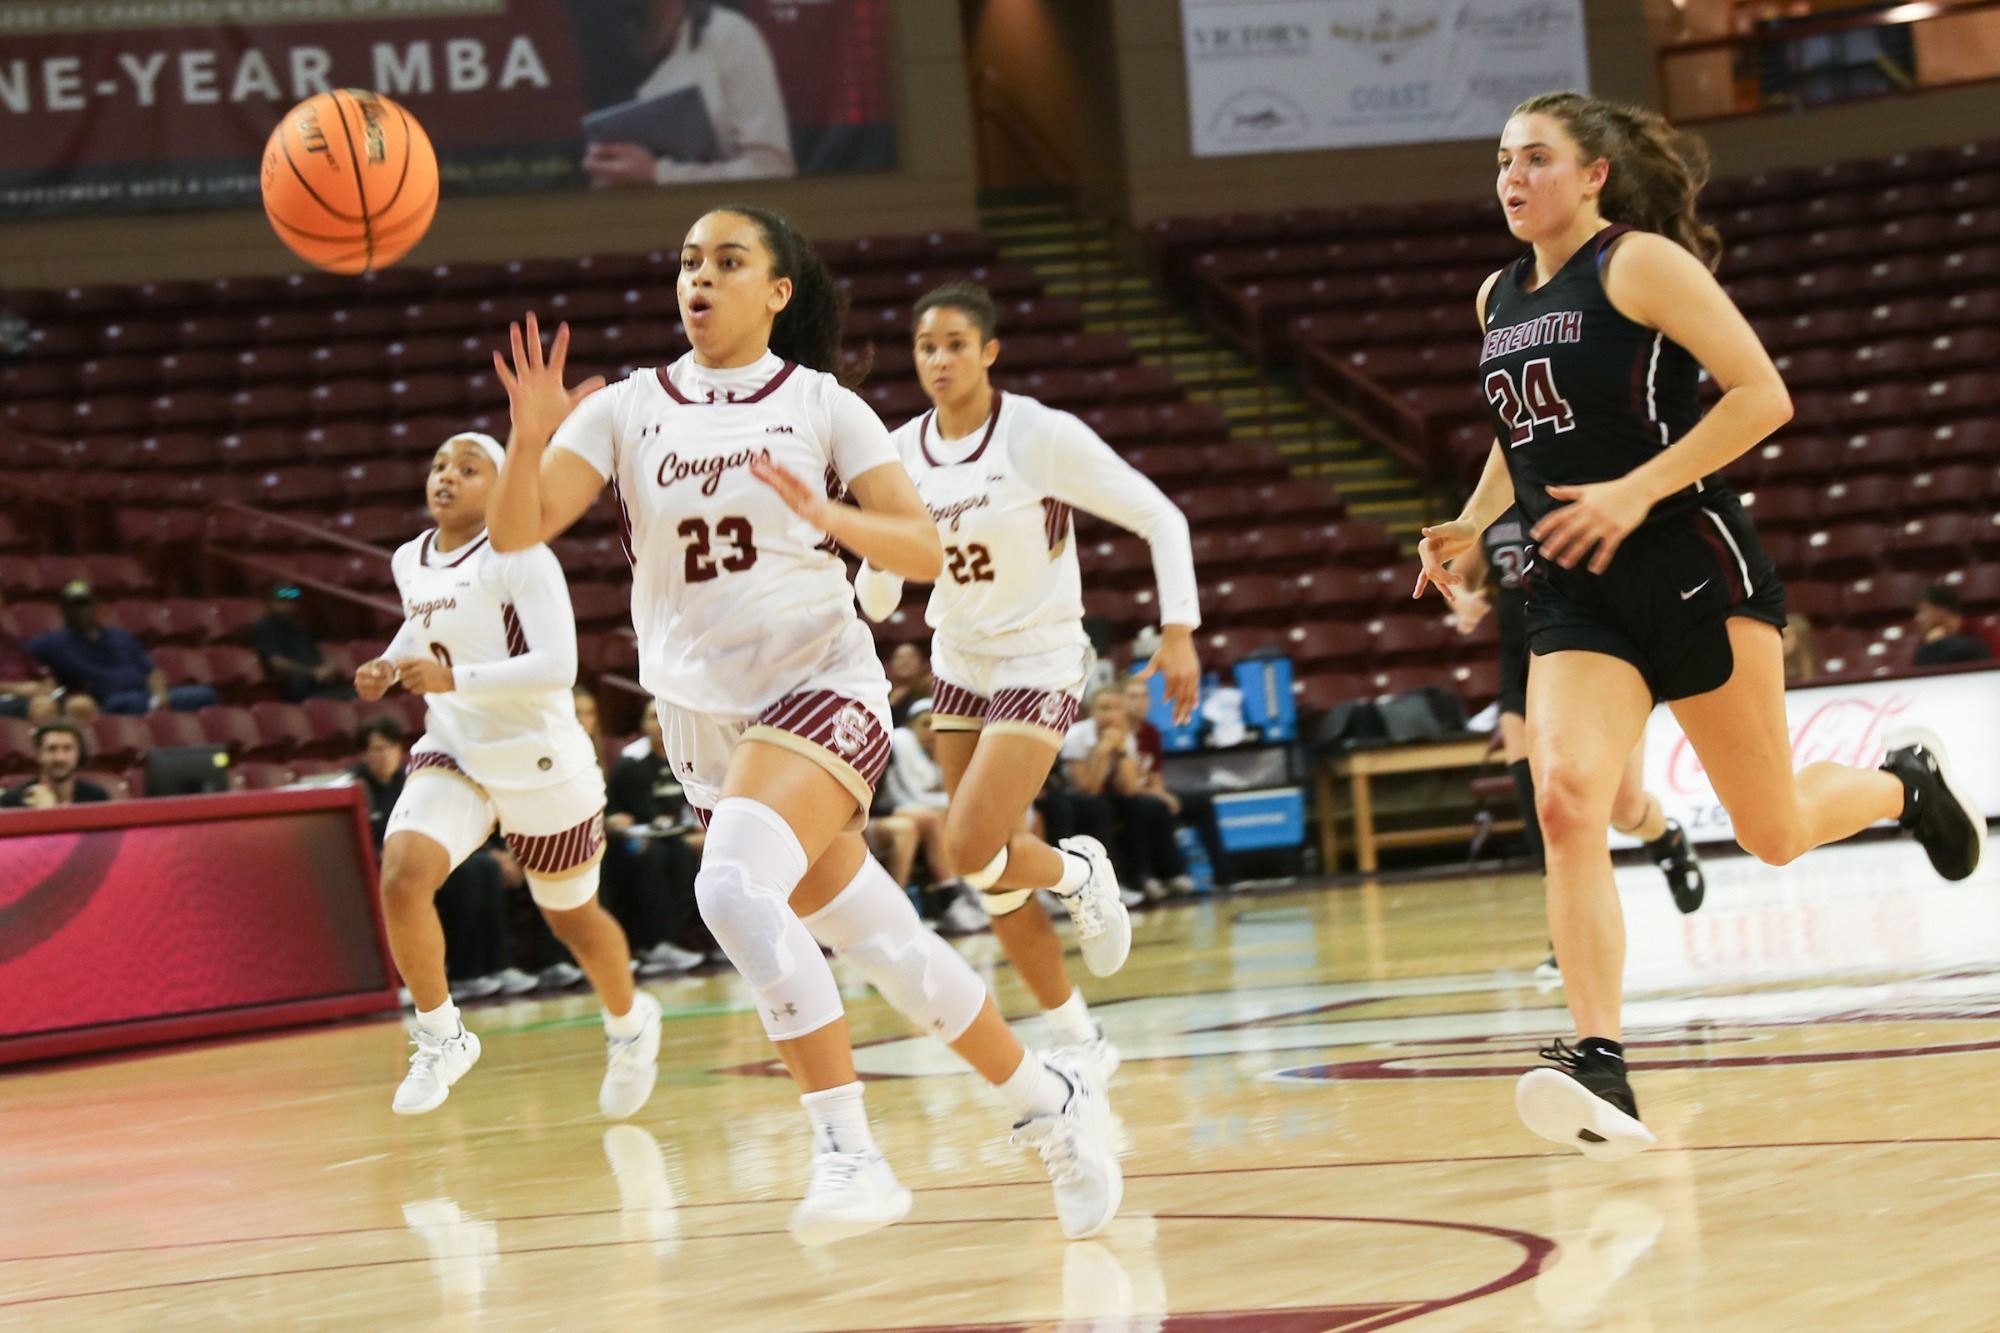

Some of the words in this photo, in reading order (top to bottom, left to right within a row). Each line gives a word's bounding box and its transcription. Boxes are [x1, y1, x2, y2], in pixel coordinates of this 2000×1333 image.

[372, 35, 549, 95] MBA
[1485, 357, 1576, 449] 24
[677, 516, 757, 583] 23
[944, 543, 995, 586] 22
